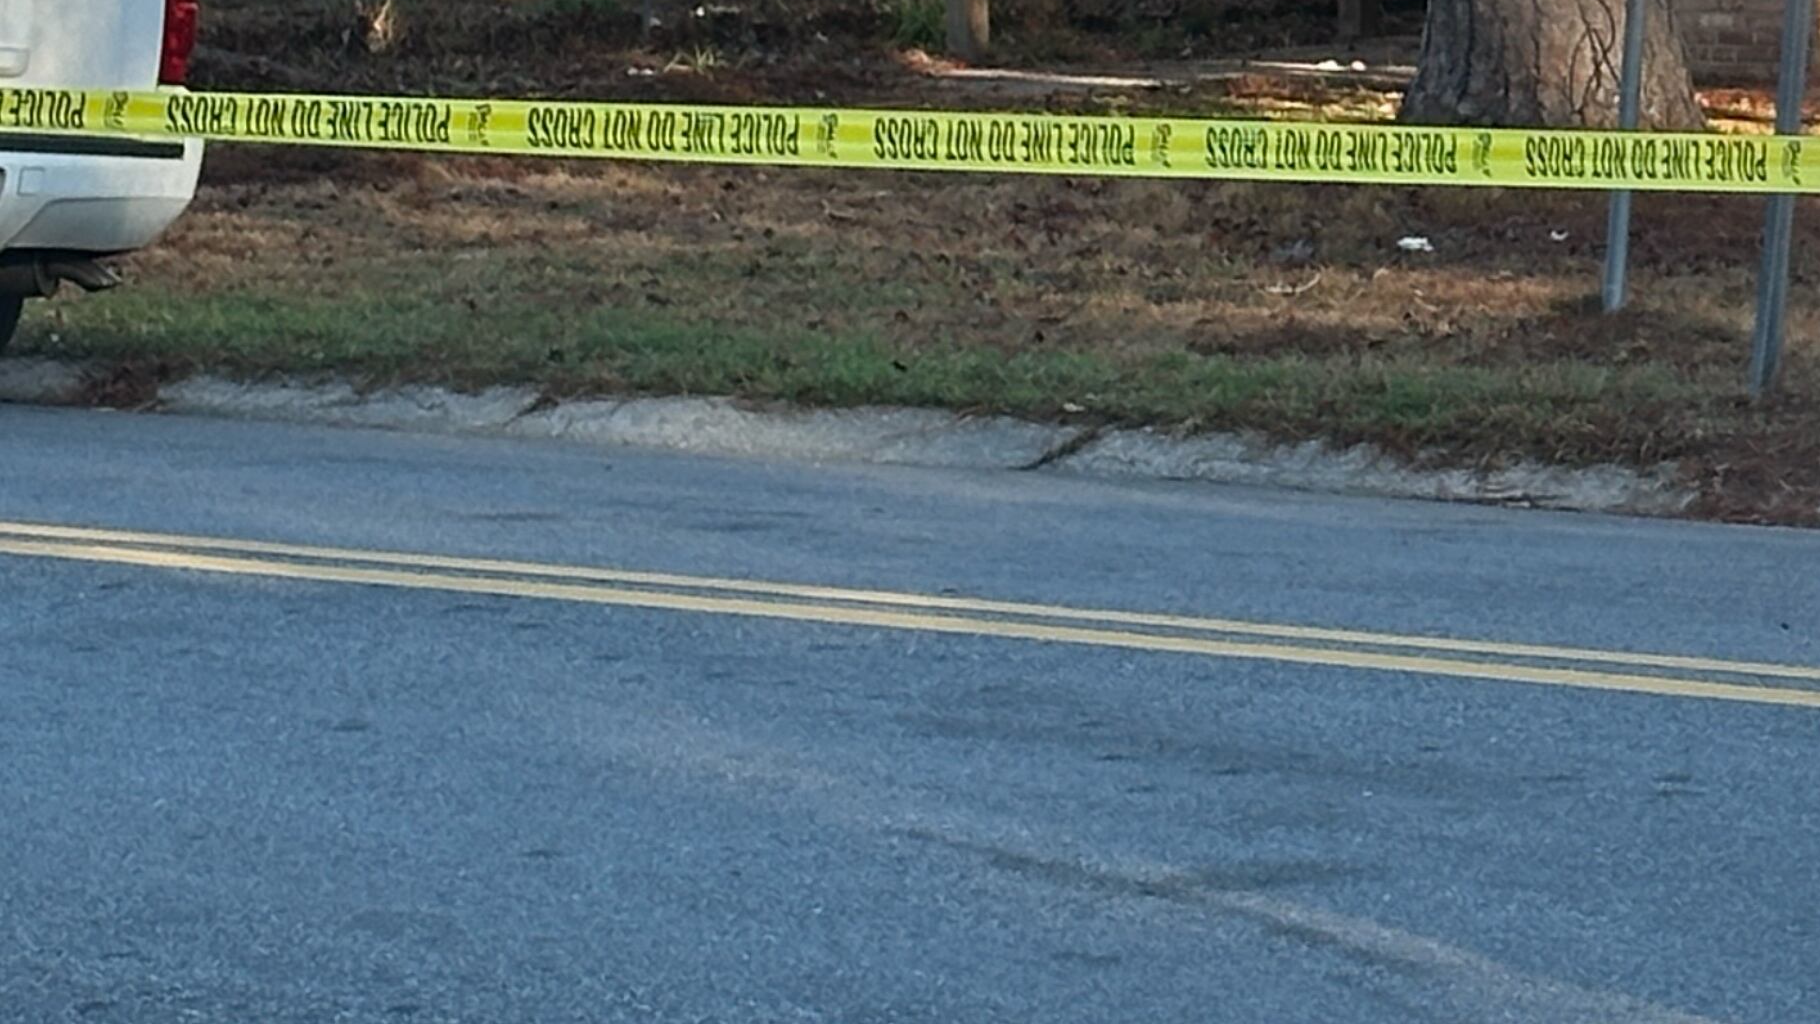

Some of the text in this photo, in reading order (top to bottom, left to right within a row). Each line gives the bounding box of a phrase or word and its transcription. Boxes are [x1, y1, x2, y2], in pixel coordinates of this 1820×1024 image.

[8, 89, 86, 129] POLICE
[165, 95, 237, 135] CROSS
[245, 98, 285, 137] NOT
[291, 100, 320, 138] DO
[326, 102, 373, 141] LINE
[377, 103, 450, 143] POLICE
[527, 107, 594, 148] CROSS
[604, 110, 642, 151] NOT
[648, 111, 676, 153] DO
[681, 112, 725, 155] LINE
[730, 114, 799, 156] POLICE
[874, 117, 939, 161] CROSS
[945, 120, 983, 162] NOT
[990, 121, 1016, 163] DO
[1020, 123, 1064, 165] LINE
[1068, 124, 1135, 166] POLICE
[1205, 128, 1268, 169] CROSS
[1274, 130, 1310, 170] NOT
[1315, 131, 1342, 171] DO
[1346, 132, 1389, 173] LINE
[1391, 133, 1457, 175] POLICE
[1526, 136, 1584, 178] CROSS
[1592, 138, 1627, 179] NOT
[1631, 139, 1657, 180] DO
[1660, 140, 1700, 181] LINE
[1704, 141, 1767, 183] POLICE
